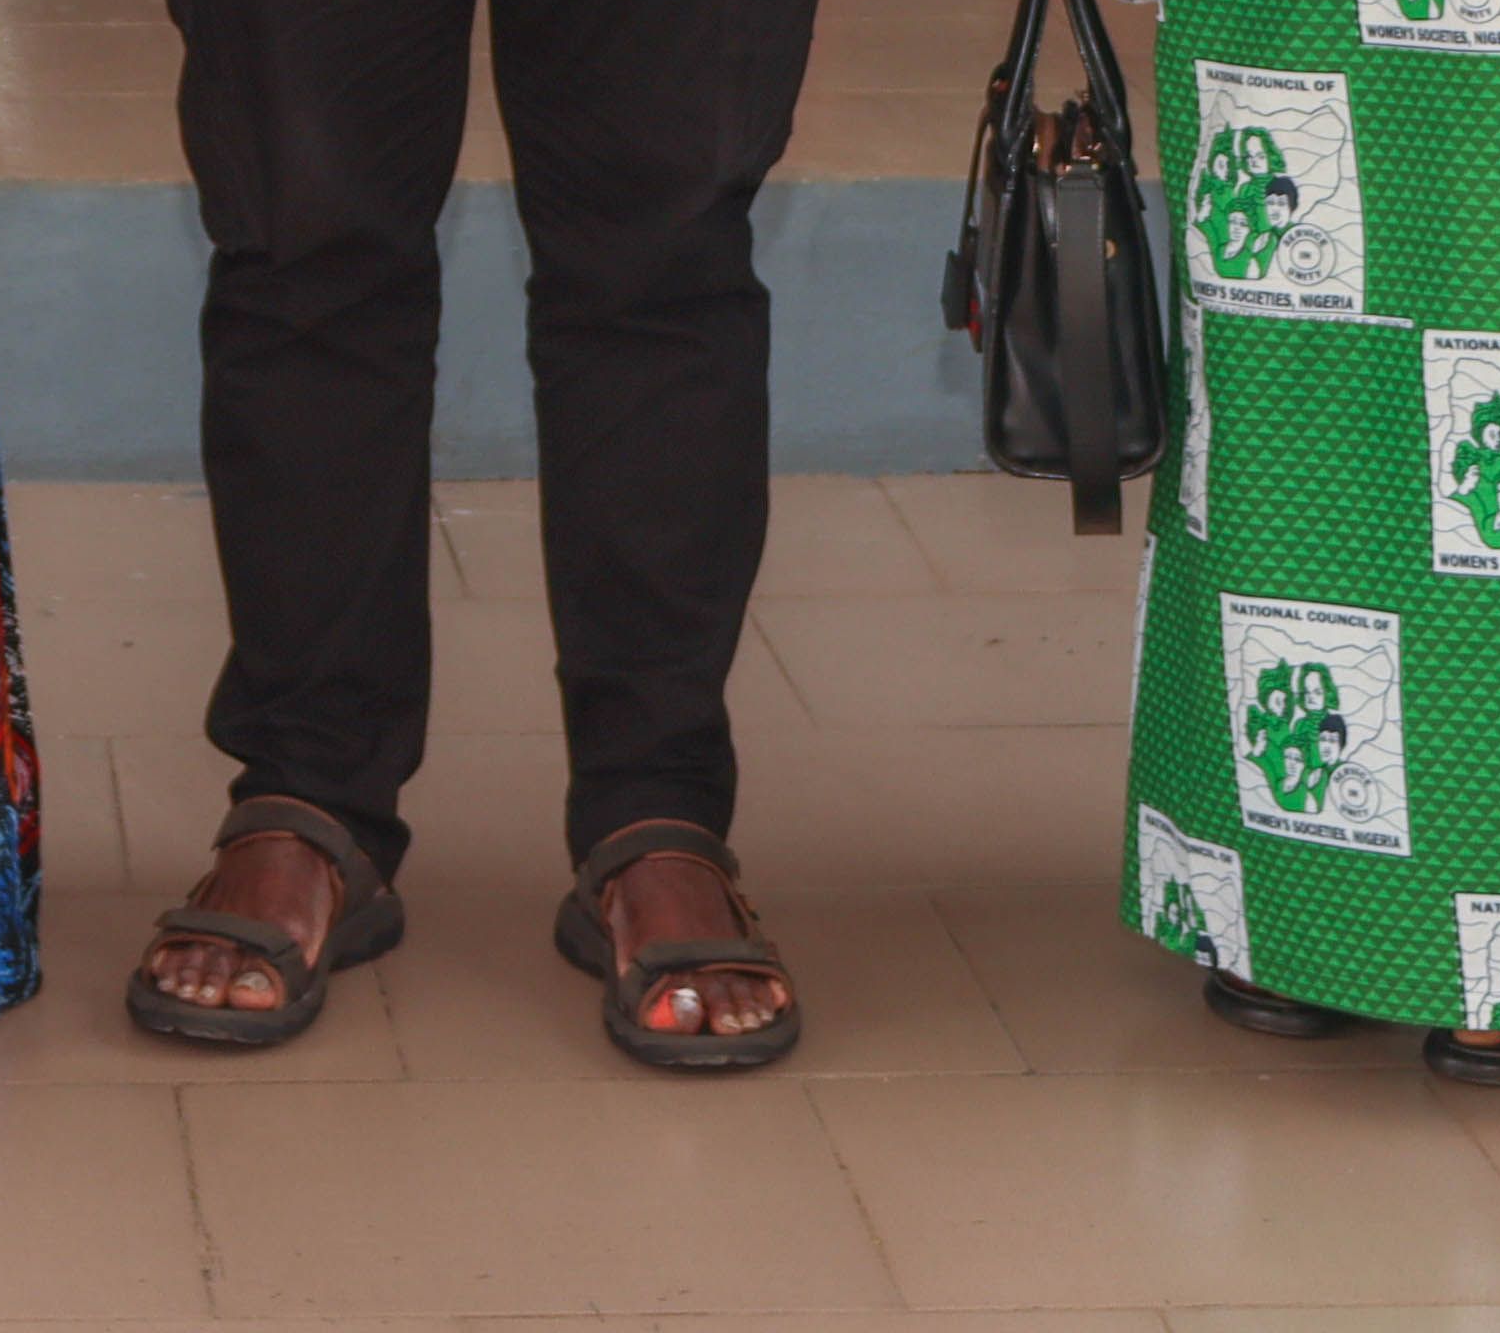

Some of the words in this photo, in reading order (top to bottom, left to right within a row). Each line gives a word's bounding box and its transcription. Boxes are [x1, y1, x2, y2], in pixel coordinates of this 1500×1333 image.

[1365, 25, 1416, 41] WOMEN'S
[1247, 74, 1309, 91] COUNCIL
[1314, 80, 1336, 91] OF
[1229, 286, 1294, 309] SOCIETIES,
[1300, 293, 1354, 310] NIGERIA
[1439, 553, 1499, 570] WOMEN'S
[1229, 602, 1303, 621] NATIONAL
[1307, 612, 1370, 628] COUNCIL
[1373, 619, 1392, 631] OF
[1247, 811, 1291, 832] WOMEN'S
[1353, 828, 1401, 849] NIGERIA
